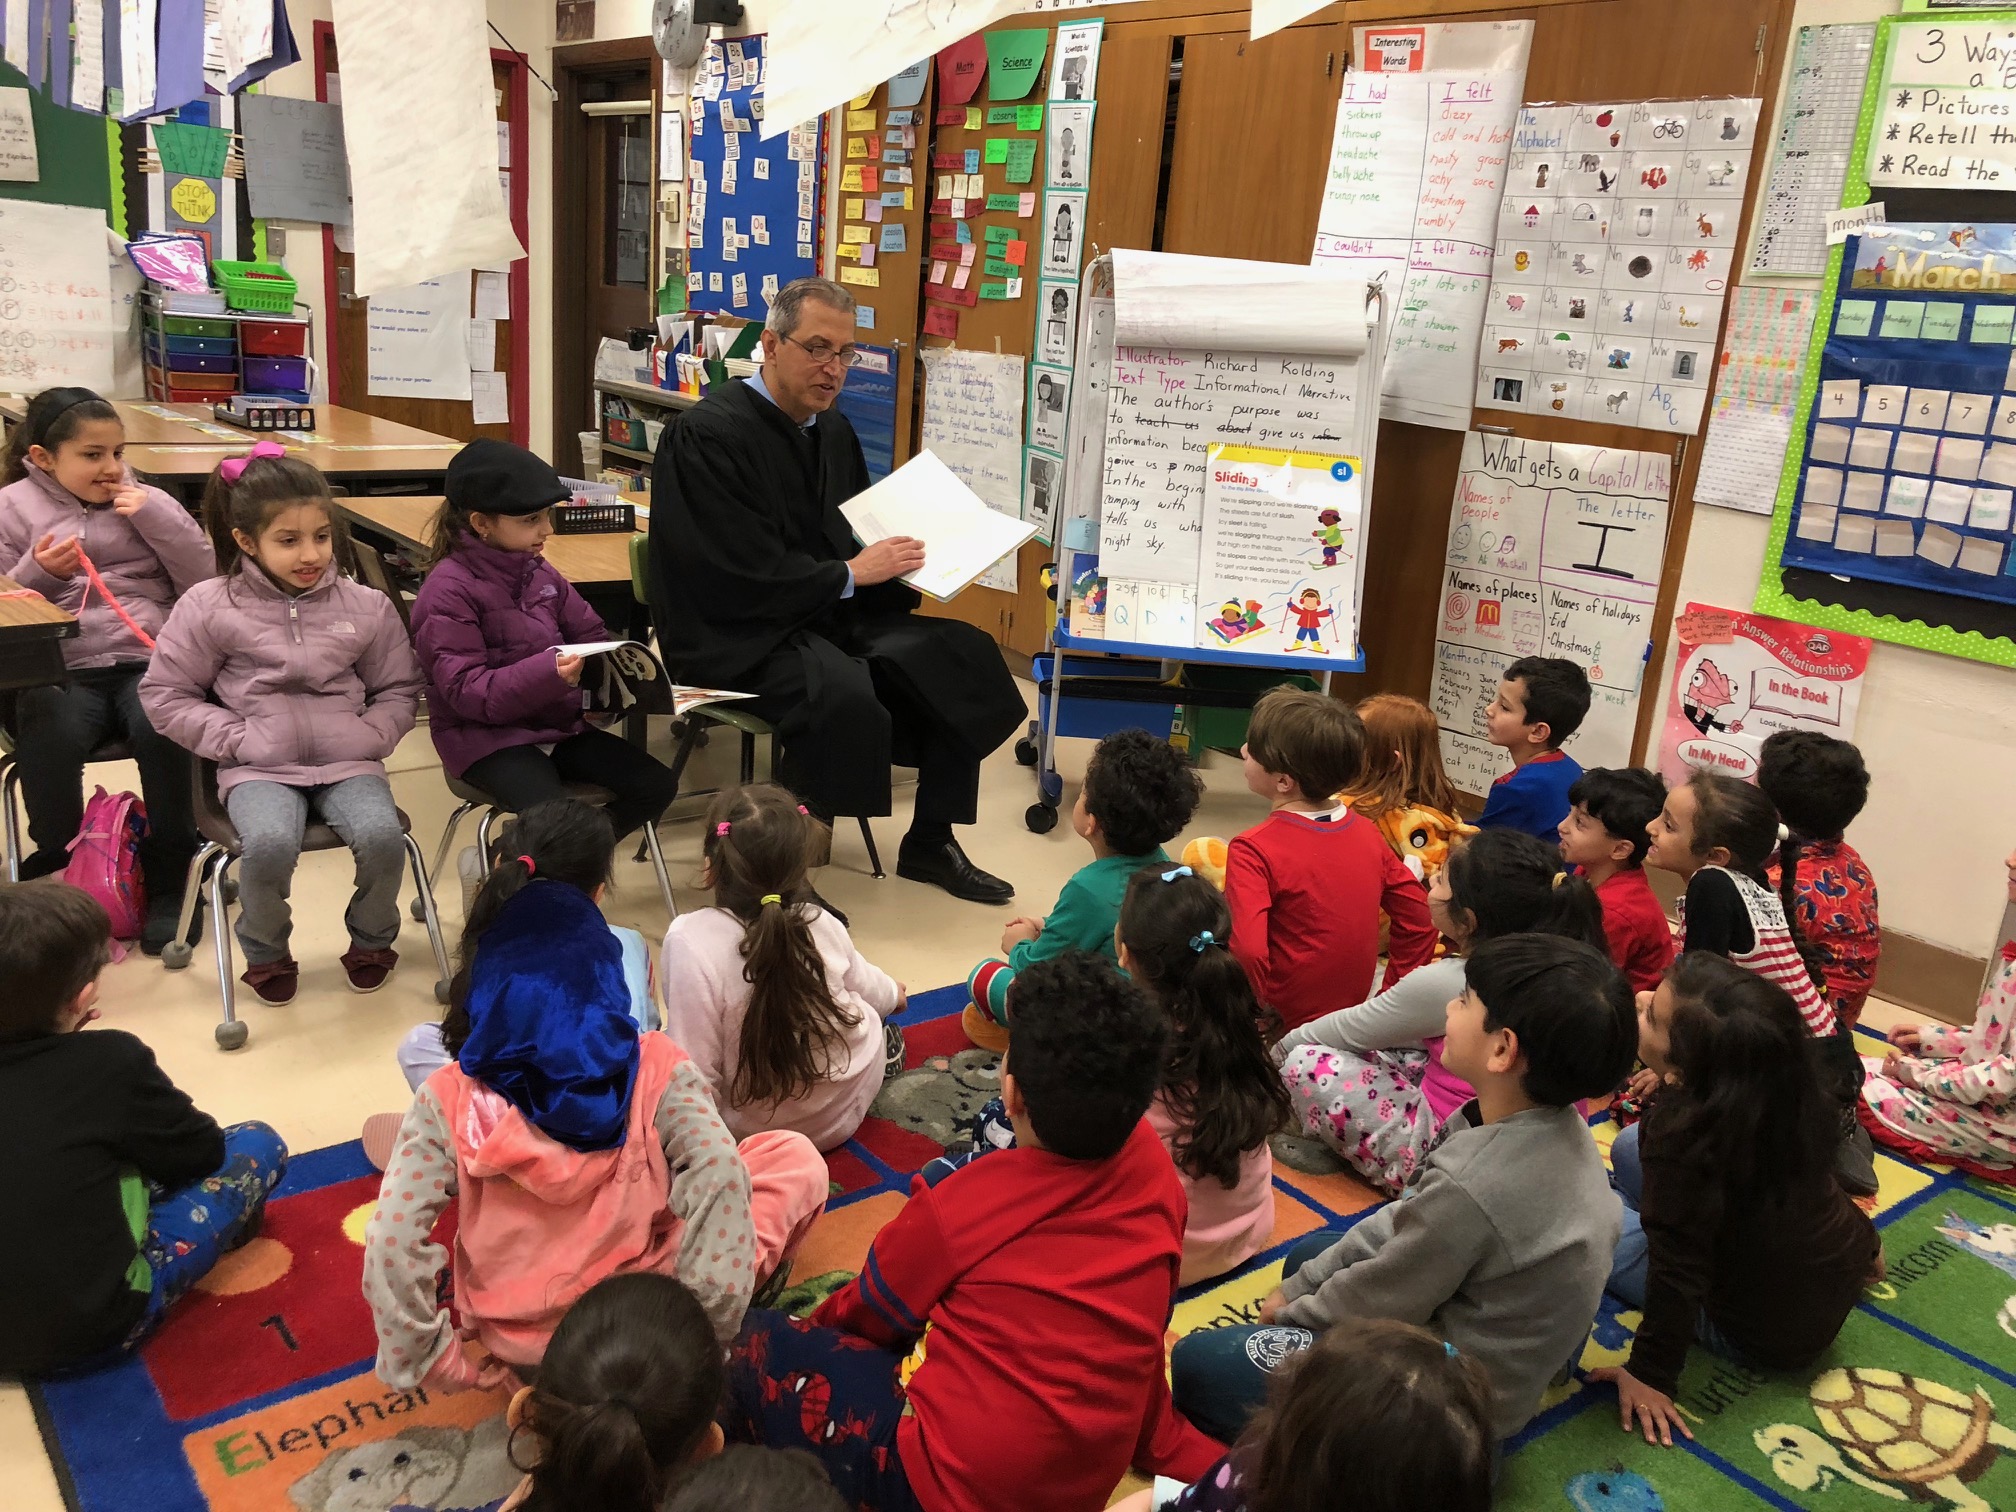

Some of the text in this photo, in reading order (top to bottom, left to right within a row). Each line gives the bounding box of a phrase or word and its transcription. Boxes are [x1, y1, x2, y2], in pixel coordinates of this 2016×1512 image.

[1374, 33, 1417, 48] Interesting
[1917, 29, 1946, 64] 3
[956, 60, 975, 72] Math
[1002, 57, 1033, 69] Science
[1383, 56, 1407, 66] Words
[1970, 73, 1984, 88] a
[1345, 83, 1387, 100] I had
[1443, 81, 1492, 100] I felt
[1922, 89, 2010, 115] Pictures
[993, 110, 1017, 121] observe
[1441, 107, 1473, 124] dizzy
[1518, 109, 1536, 125] The
[1633, 105, 1650, 123] Bb
[1433, 126, 1512, 143] cold and hot
[1514, 130, 1561, 151] Alphabet
[1909, 122, 1977, 144] Retell
[1336, 146, 1378, 160] headache
[1430, 151, 1505, 172] nasty gross
[1353, 167, 1374, 181] ache
[1902, 154, 1999, 180] Read the
[177, 184, 209, 199] STOP
[1429, 173, 1495, 193] achy sore
[177, 201, 211, 218] THINK
[989, 198, 1019, 209] vibrations
[1418, 214, 1456, 231] rumbly
[1833, 207, 1884, 233] month
[1334, 240, 1373, 254] couldn't
[1432, 240, 1455, 254] felt
[1410, 258, 1432, 267] when
[1892, 251, 2001, 290] March
[1410, 275, 1480, 292] got lots of
[1398, 313, 1417, 328] hot
[1395, 335, 1413, 351] got
[1421, 337, 1430, 349] to
[1115, 346, 1335, 383] Illustrator Richard Kolding
[1115, 366, 1351, 401] Text Type Informational Narrative
[1110, 386, 1319, 420] The author's purpose was
[1834, 393, 1844, 405] 4
[1878, 398, 1888, 410] 5
[1920, 403, 1930, 415] 6
[1961, 407, 1972, 419] 7
[1110, 409, 1123, 424] to
[1259, 428, 1283, 440] give
[1290, 431, 1304, 439] us
[1107, 430, 1168, 449] information
[1146, 460, 1157, 470] us
[1481, 433, 1527, 473] What
[1530, 442, 1562, 487] gets
[1569, 467, 1579, 482] a
[1589, 449, 1640, 492] Capital
[1215, 471, 1258, 487] Sliding
[1458, 474, 1513, 504] Names of
[1104, 495, 1185, 511] camping with
[1577, 498, 1655, 520] The letter
[1106, 511, 1128, 526] tells
[1461, 505, 1500, 522] people
[1104, 533, 1131, 551] night
[1572, 521, 1636, 579] I
[1449, 571, 1538, 603] Names of places
[1114, 605, 1129, 625] Q
[1550, 590, 1641, 625] Names of holidays
[1444, 620, 1468, 637] Target
[1550, 631, 1592, 656] Christmas
[1742, 620, 1854, 678] Answer Relationships
[1807, 642, 1830, 653] QAR
[1439, 644, 1506, 671] Months of the
[1440, 661, 1470, 680] January
[1439, 674, 1473, 694] February
[1479, 674, 1498, 686] June
[1480, 686, 1496, 697] July
[1605, 692, 1626, 707] week
[1769, 679, 1829, 705] In the Book
[1437, 695, 1459, 708] April
[1436, 705, 1451, 720] May
[1759, 717, 1789, 730] Look for
[1452, 735, 1511, 762] beginning of
[1446, 756, 1461, 766] cat
[1480, 763, 1497, 776] lost
[1688, 745, 1746, 771] In My Head
[1469, 779, 1483, 792] the
[259, 1314, 299, 1351] 1
